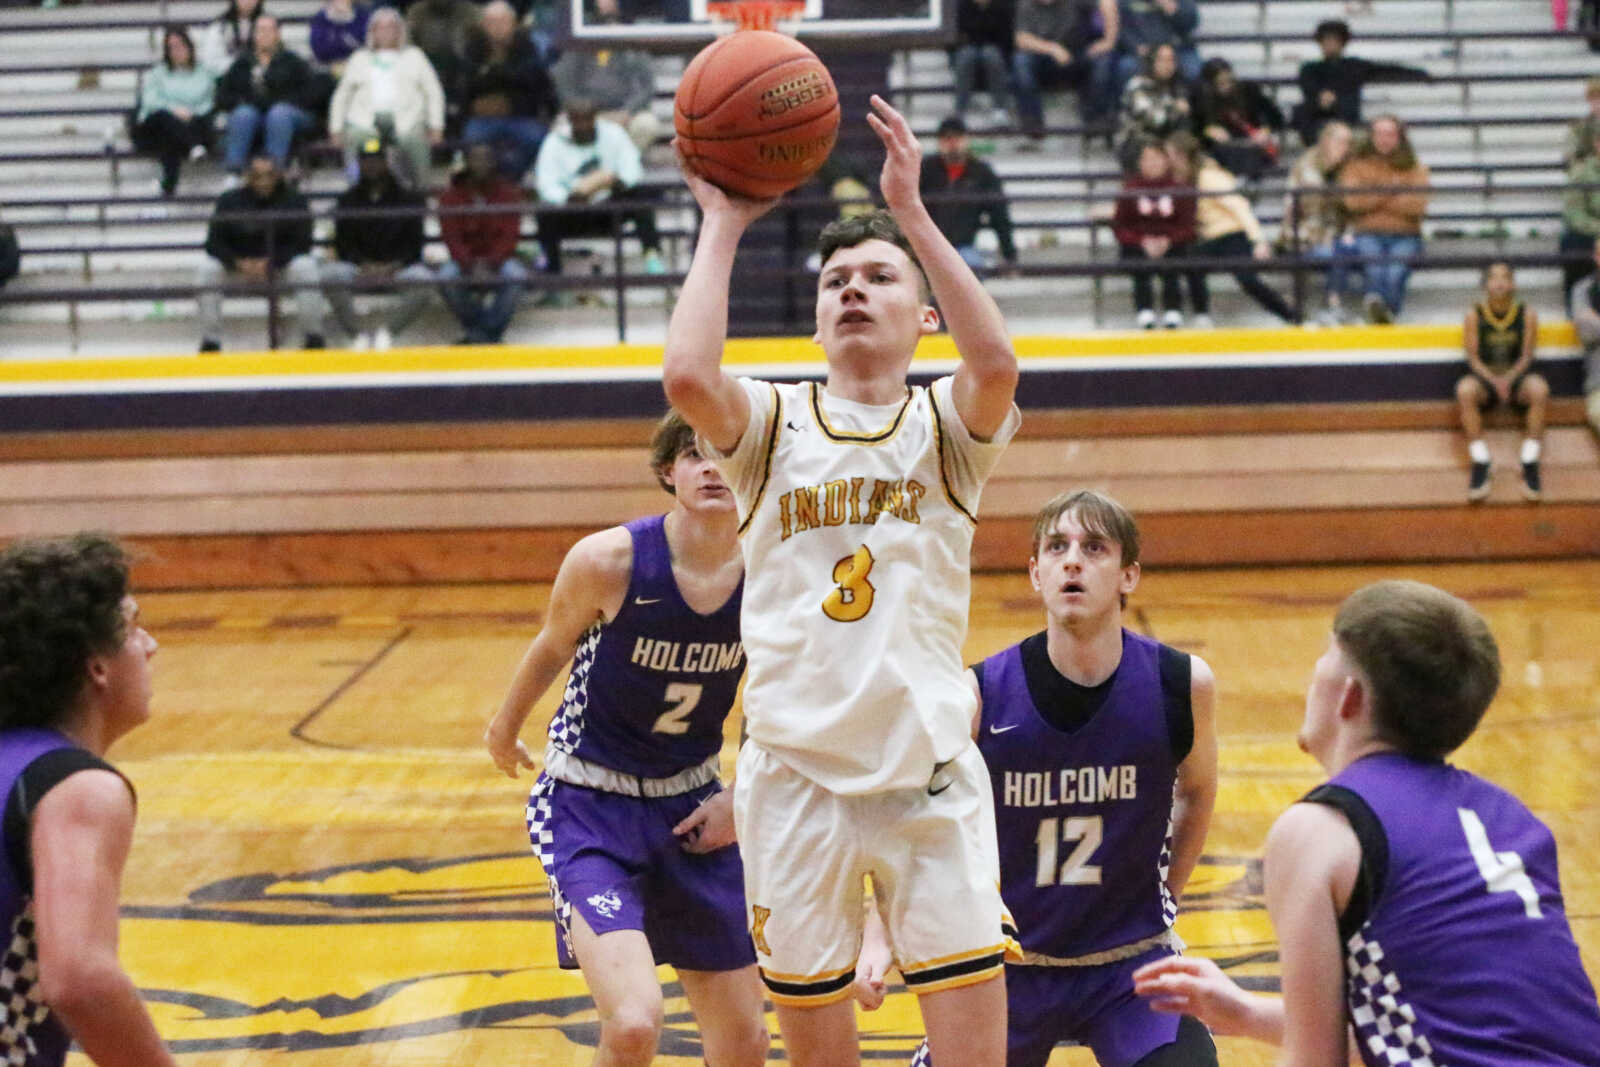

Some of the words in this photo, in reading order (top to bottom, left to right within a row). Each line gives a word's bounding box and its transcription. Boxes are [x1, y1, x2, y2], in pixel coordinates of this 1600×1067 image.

[822, 543, 876, 622] 3
[651, 682, 704, 735] 2
[1004, 765, 1137, 807] HOLCOMB
[1035, 815, 1104, 887] 12
[1456, 806, 1545, 919] 4
[752, 904, 772, 956] K
